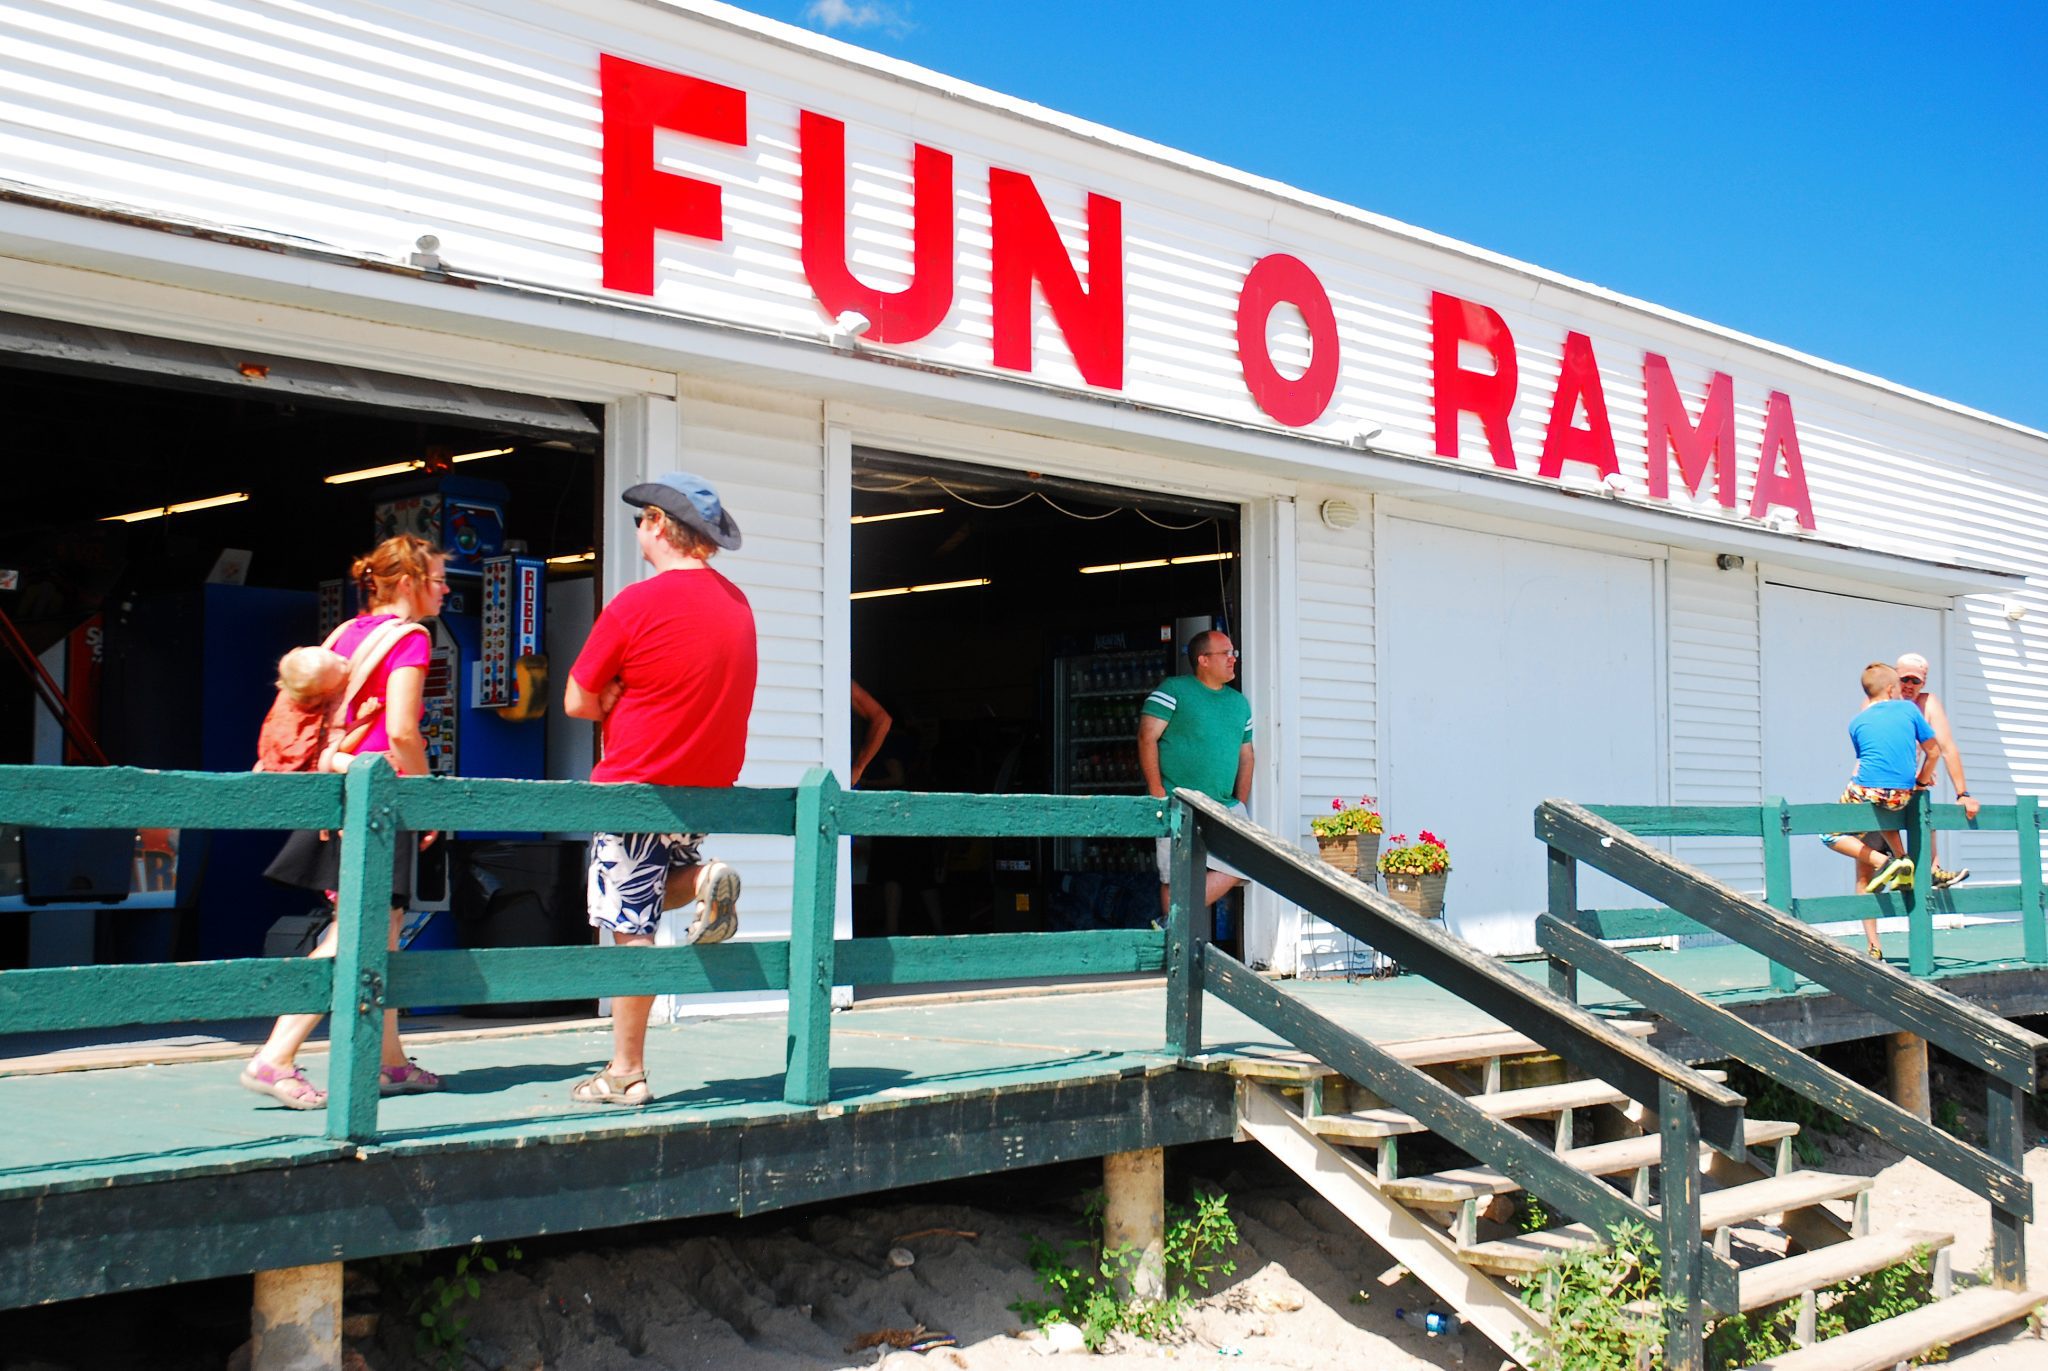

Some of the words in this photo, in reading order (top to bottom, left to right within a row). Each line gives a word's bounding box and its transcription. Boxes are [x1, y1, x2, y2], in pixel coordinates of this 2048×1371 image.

[599, 53, 1124, 390] FUN
[1236, 253, 1340, 427] O
[1430, 290, 1817, 530] RAMA
